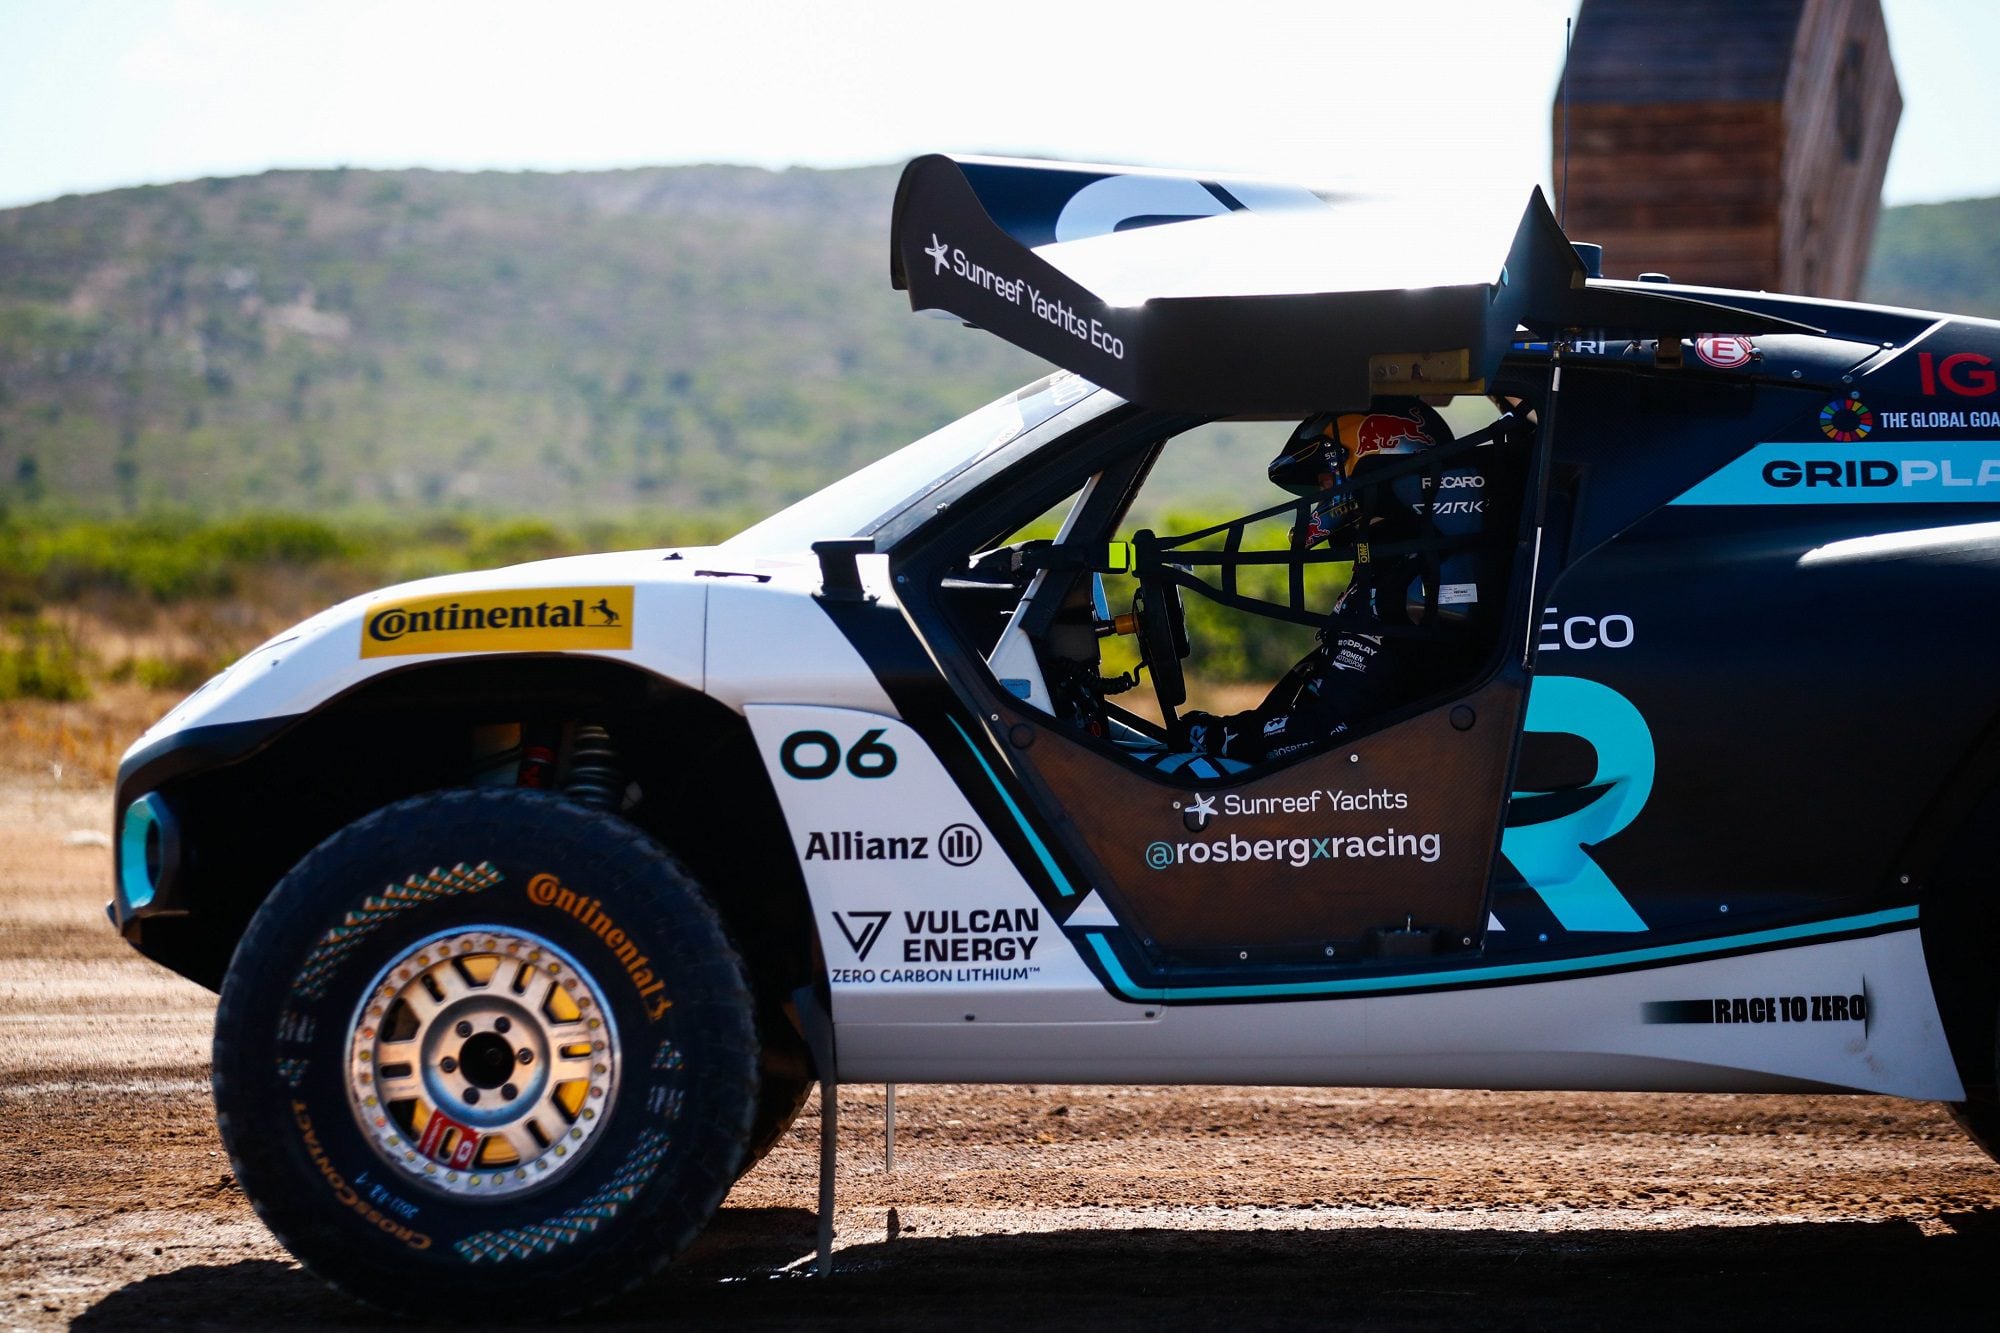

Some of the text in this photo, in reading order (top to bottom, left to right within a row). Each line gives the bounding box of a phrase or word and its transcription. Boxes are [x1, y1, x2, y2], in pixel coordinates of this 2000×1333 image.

[953, 249, 1124, 359] Sunreef Yachts Eco
[1711, 339, 1736, 360] E
[1918, 352, 1998, 397] IG
[1880, 412, 1909, 428] THE
[1911, 411, 1968, 428] GLOBAL
[1359, 543, 1369, 564] OMP
[369, 599, 585, 642] Continental
[1340, 649, 1364, 663] WOMEN
[780, 728, 898, 780] 06
[1224, 788, 1408, 815] Sunreef Yachts
[804, 831, 929, 861] Allianz
[1145, 828, 1441, 869] @rosbergxracing
[904, 908, 1039, 934] VULCAN
[527, 873, 666, 999] Continental
[904, 937, 1039, 963] ENERGY
[832, 968, 875, 983] ZERO
[880, 967, 953, 983] CARBON
[1715, 994, 1866, 1024] RACE TO ZERO
